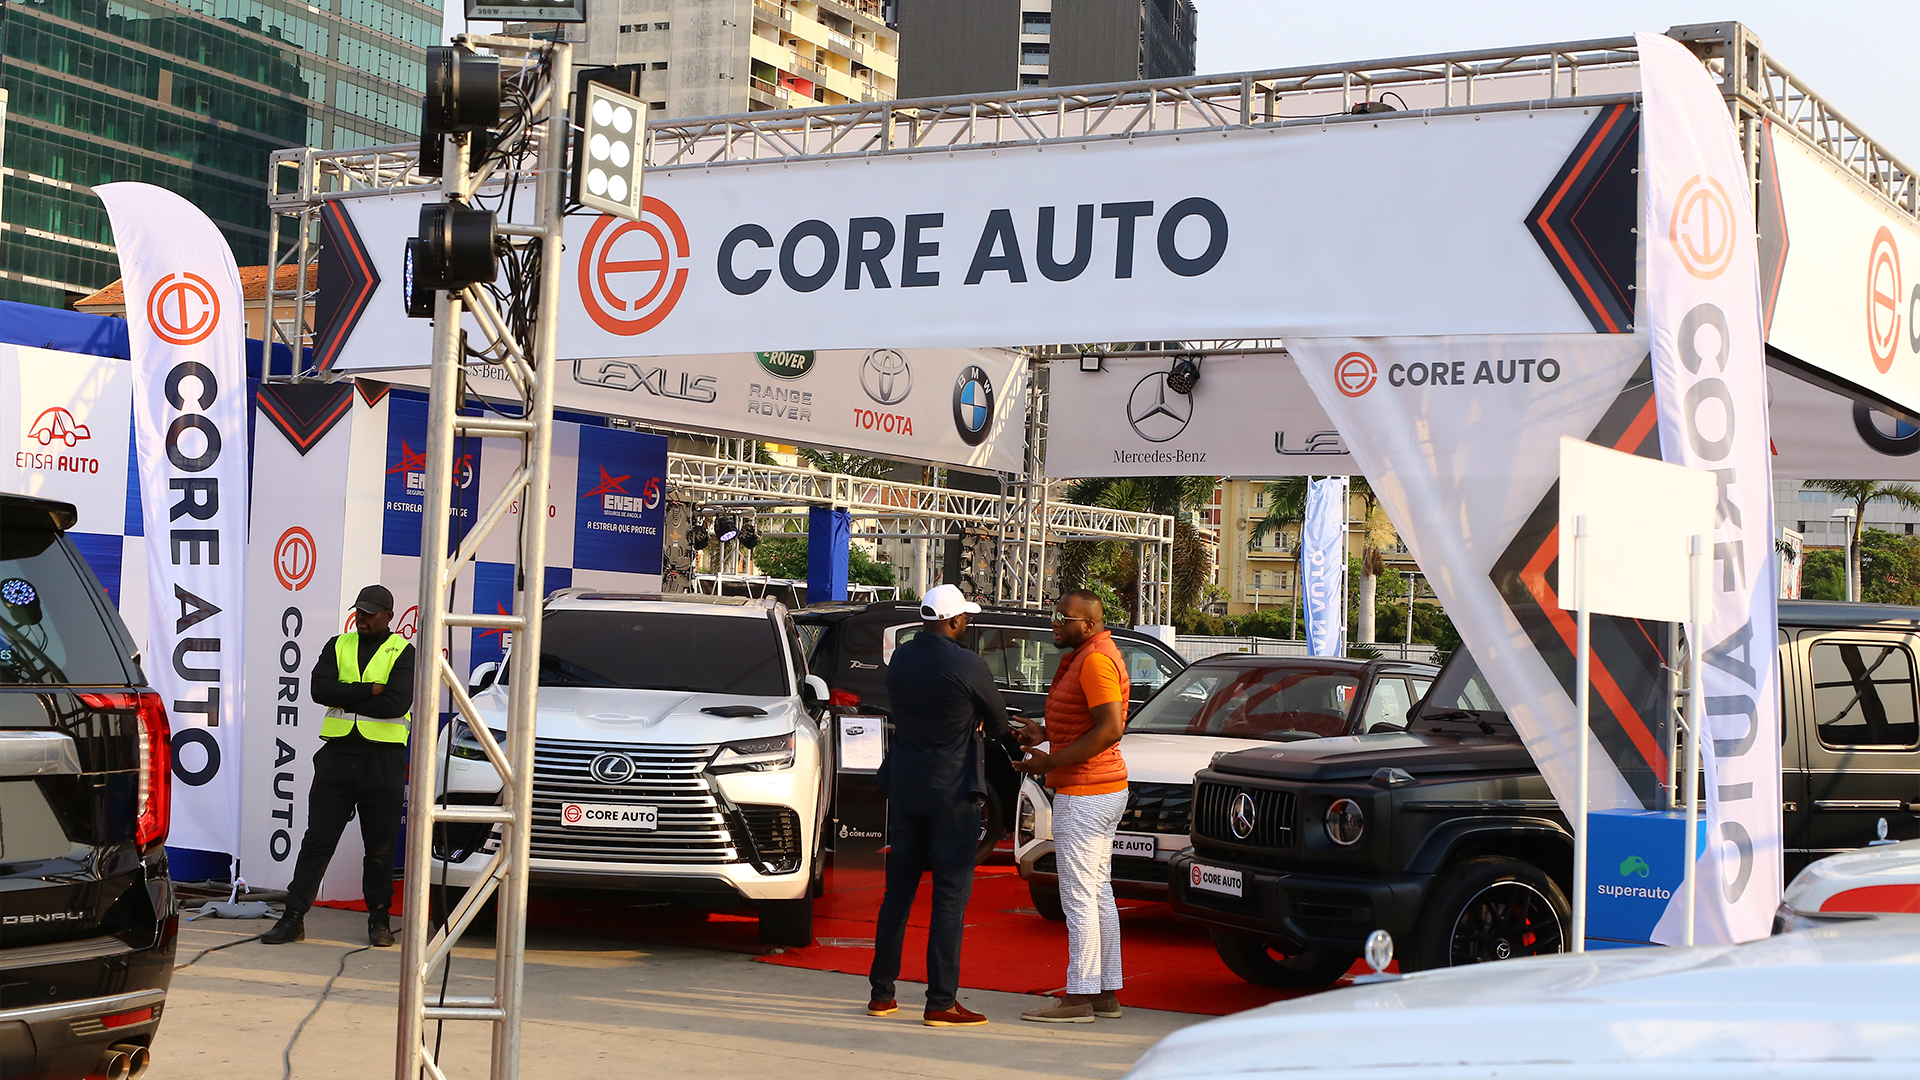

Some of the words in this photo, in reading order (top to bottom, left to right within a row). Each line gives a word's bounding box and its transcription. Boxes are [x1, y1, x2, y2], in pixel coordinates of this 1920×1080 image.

[717, 212, 944, 296] CORE
[963, 196, 1229, 285] AUTO
[768, 351, 806, 370] ROVER
[573, 359, 717, 404] LEXUS
[957, 367, 992, 394] BMW
[1388, 361, 1466, 388] CORE
[1472, 358, 1561, 384] AUTO
[749, 383, 813, 406] RANGE
[747, 400, 813, 422] ROVER
[853, 408, 913, 436] TOYOTA
[15, 451, 53, 470] ENSA
[58, 455, 99, 474] AUTO
[165, 361, 222, 565] CORE
[1113, 449, 1207, 463] Mercedes-Benz
[406, 471, 427, 490] EN
[405, 489, 425, 497] SEGURO
[386, 501, 392, 510] A
[393, 501, 422, 513] ESTRELA
[604, 494, 643, 513] ENSA
[587, 520, 592, 529] A
[592, 521, 617, 532] ESTRELA
[617, 524, 630, 533] QUE
[630, 525, 656, 536] PROTEGE
[277, 606, 303, 727] CORE
[173, 582, 223, 787] AUTO
[269, 737, 296, 863] AUTO
[585, 809, 618, 821] CORE
[621, 811, 655, 823] AUTO
[1112, 840, 1124, 850] RE
[1125, 841, 1153, 852] AUTO
[1202, 872, 1221, 886] CORE
[1221, 875, 1242, 889] AUTO
[1597, 884, 1671, 900] superauto
[2, 911, 83, 925] DENALI
